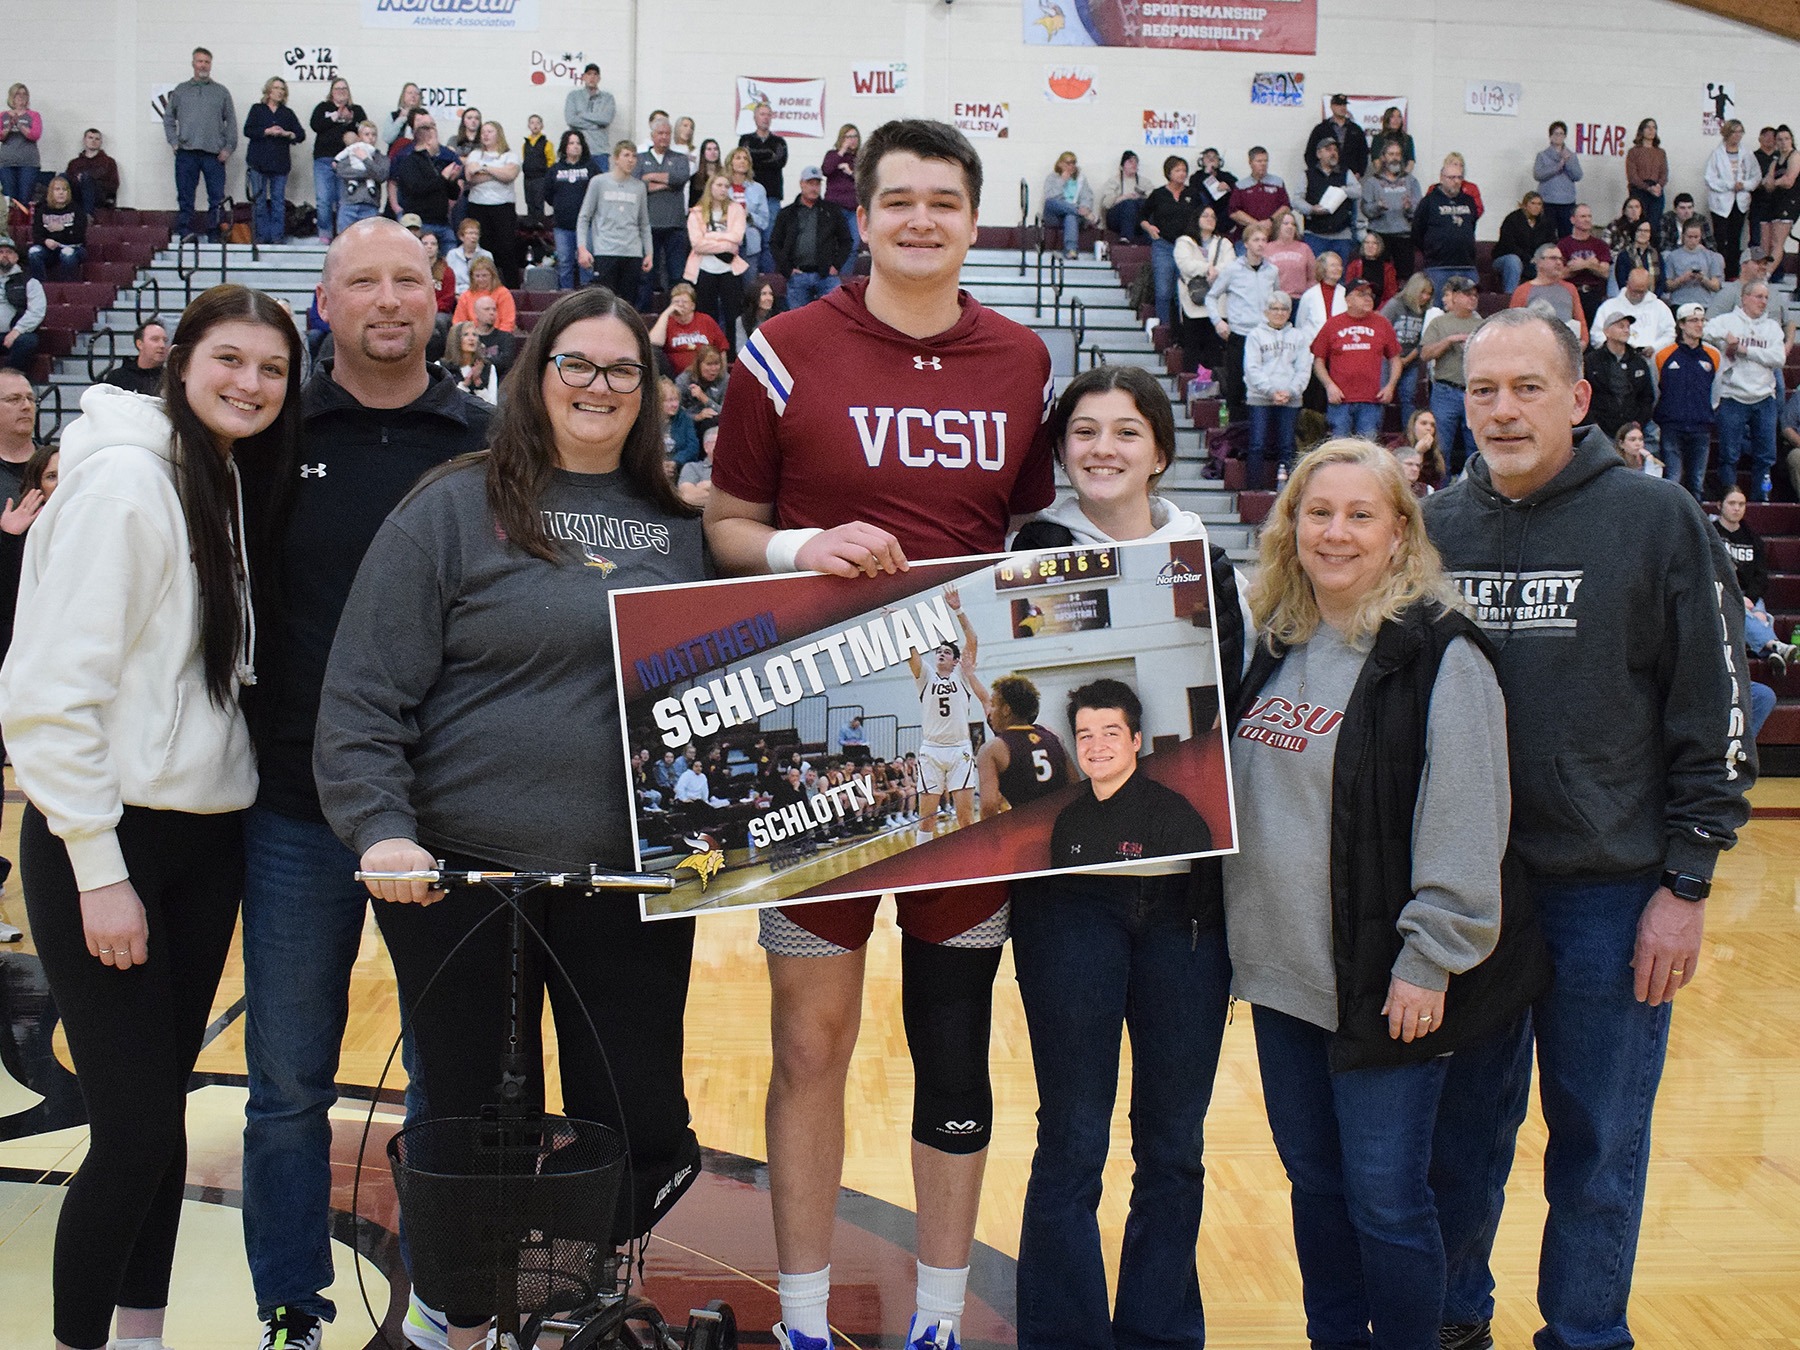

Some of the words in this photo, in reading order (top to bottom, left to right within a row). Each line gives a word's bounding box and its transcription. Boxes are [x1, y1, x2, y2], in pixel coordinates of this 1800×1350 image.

[1142, 3, 1267, 20] SPORTSMANSHIP
[413, 16, 452, 26] Athletic
[456, 17, 516, 27] Association
[1142, 24, 1263, 41] RESPONSIBILITY
[284, 47, 305, 66] GO
[294, 65, 338, 80] TATE
[853, 71, 895, 94] WILL
[779, 97, 813, 107] HOME
[954, 103, 1003, 119] EMMA
[1337, 326, 1375, 337] VCSU
[849, 406, 1007, 471] VCSU
[1039, 560, 1057, 577] 22
[1063, 559, 1071, 573] 1
[1077, 555, 1088, 572] 6
[1099, 553, 1110, 568] 5
[1156, 573, 1202, 586] NorthStar
[1521, 579, 1582, 606] CITY
[634, 611, 780, 691] MATTHEW
[652, 595, 960, 748] SCHLOTTMAN
[932, 681, 958, 695] VCSU
[938, 697, 951, 717] 5
[1031, 749, 1053, 783] 5
[747, 774, 876, 849] SCHLOTTY
